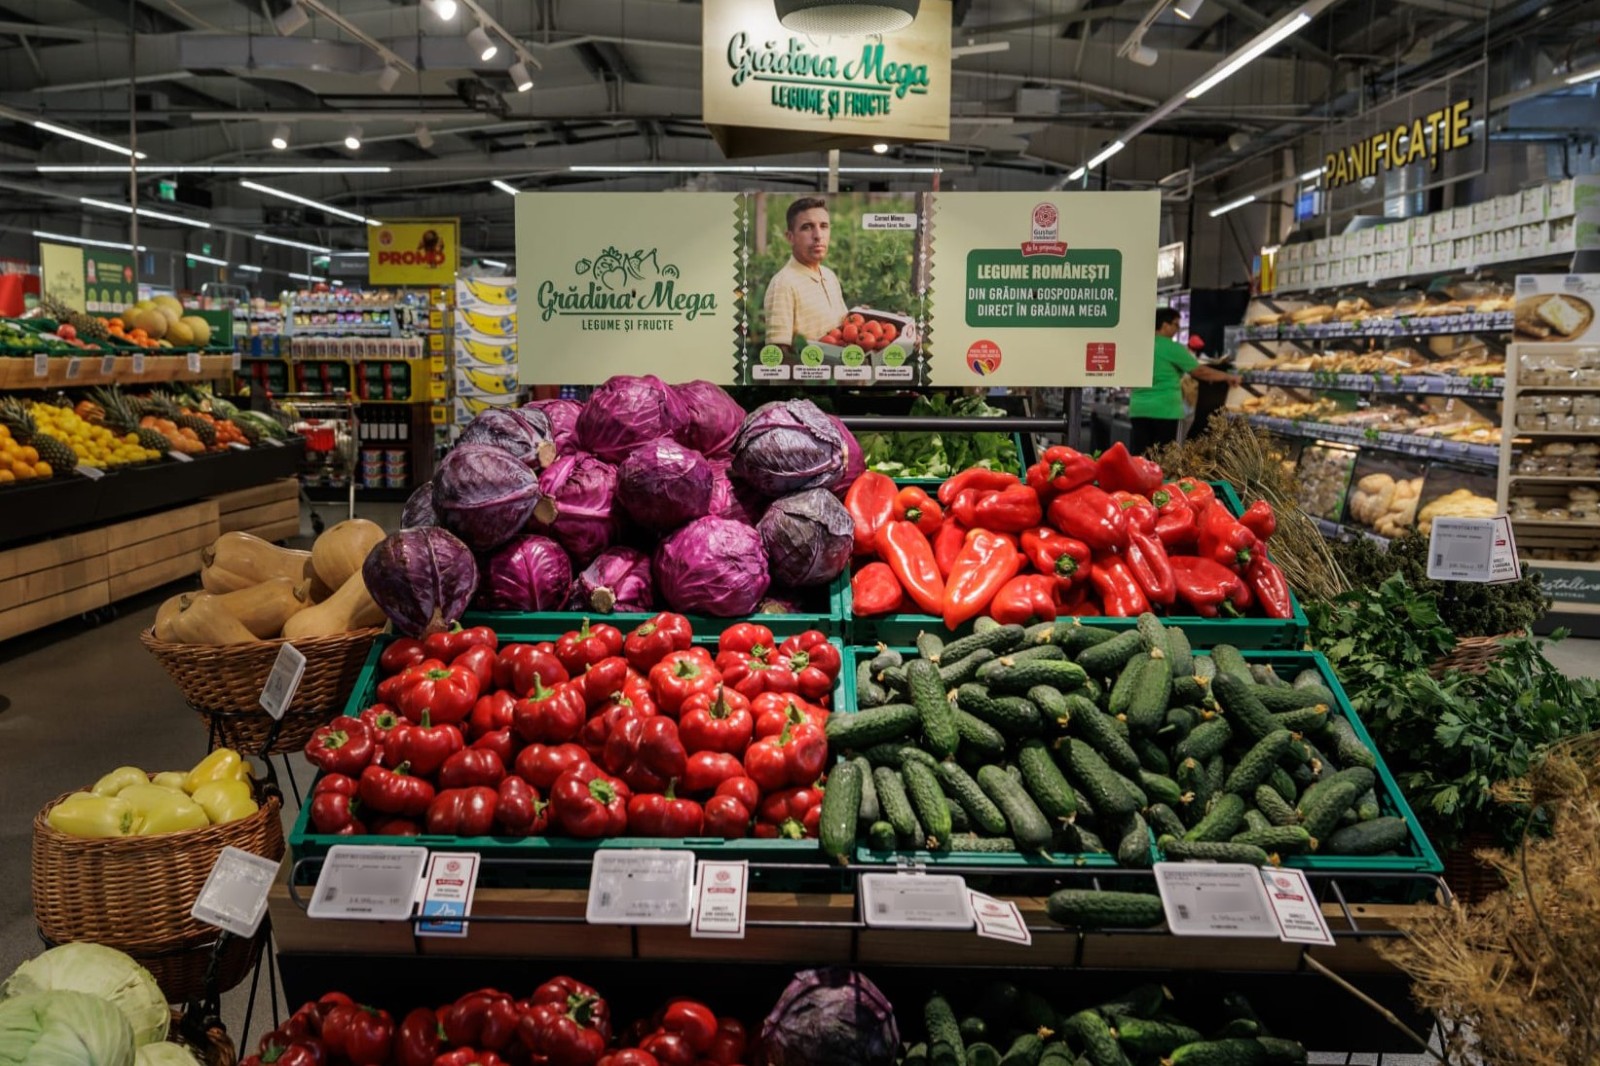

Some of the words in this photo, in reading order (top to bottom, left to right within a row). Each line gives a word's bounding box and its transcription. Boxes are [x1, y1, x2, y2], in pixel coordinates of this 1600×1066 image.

[728, 32, 838, 86] Grădina
[843, 44, 930, 98] Mega
[772, 85, 824, 115] LEGUME
[828, 91, 840, 120] ȘI
[844, 93, 890, 115] FRUCTE
[1324, 99, 1471, 188] PANIFICAȚIE
[378, 251, 445, 265] PROMO
[977, 264, 1030, 279] LEGUME
[1032, 261, 1110, 283] ROMÂNEȘTI
[537, 280, 632, 321] Grădina
[637, 280, 717, 321] Mega
[968, 287, 986, 300] DIN
[989, 285, 1034, 300] GRĂDINA
[977, 304, 1014, 316] DIRECT
[1016, 302, 1027, 316] ÎN
[1030, 302, 1076, 317] GRĂDINA
[1078, 304, 1107, 317] MEGA
[582, 319, 621, 331] LEGUME
[624, 319, 634, 333] ȘI
[637, 319, 674, 331] FRUCTE
